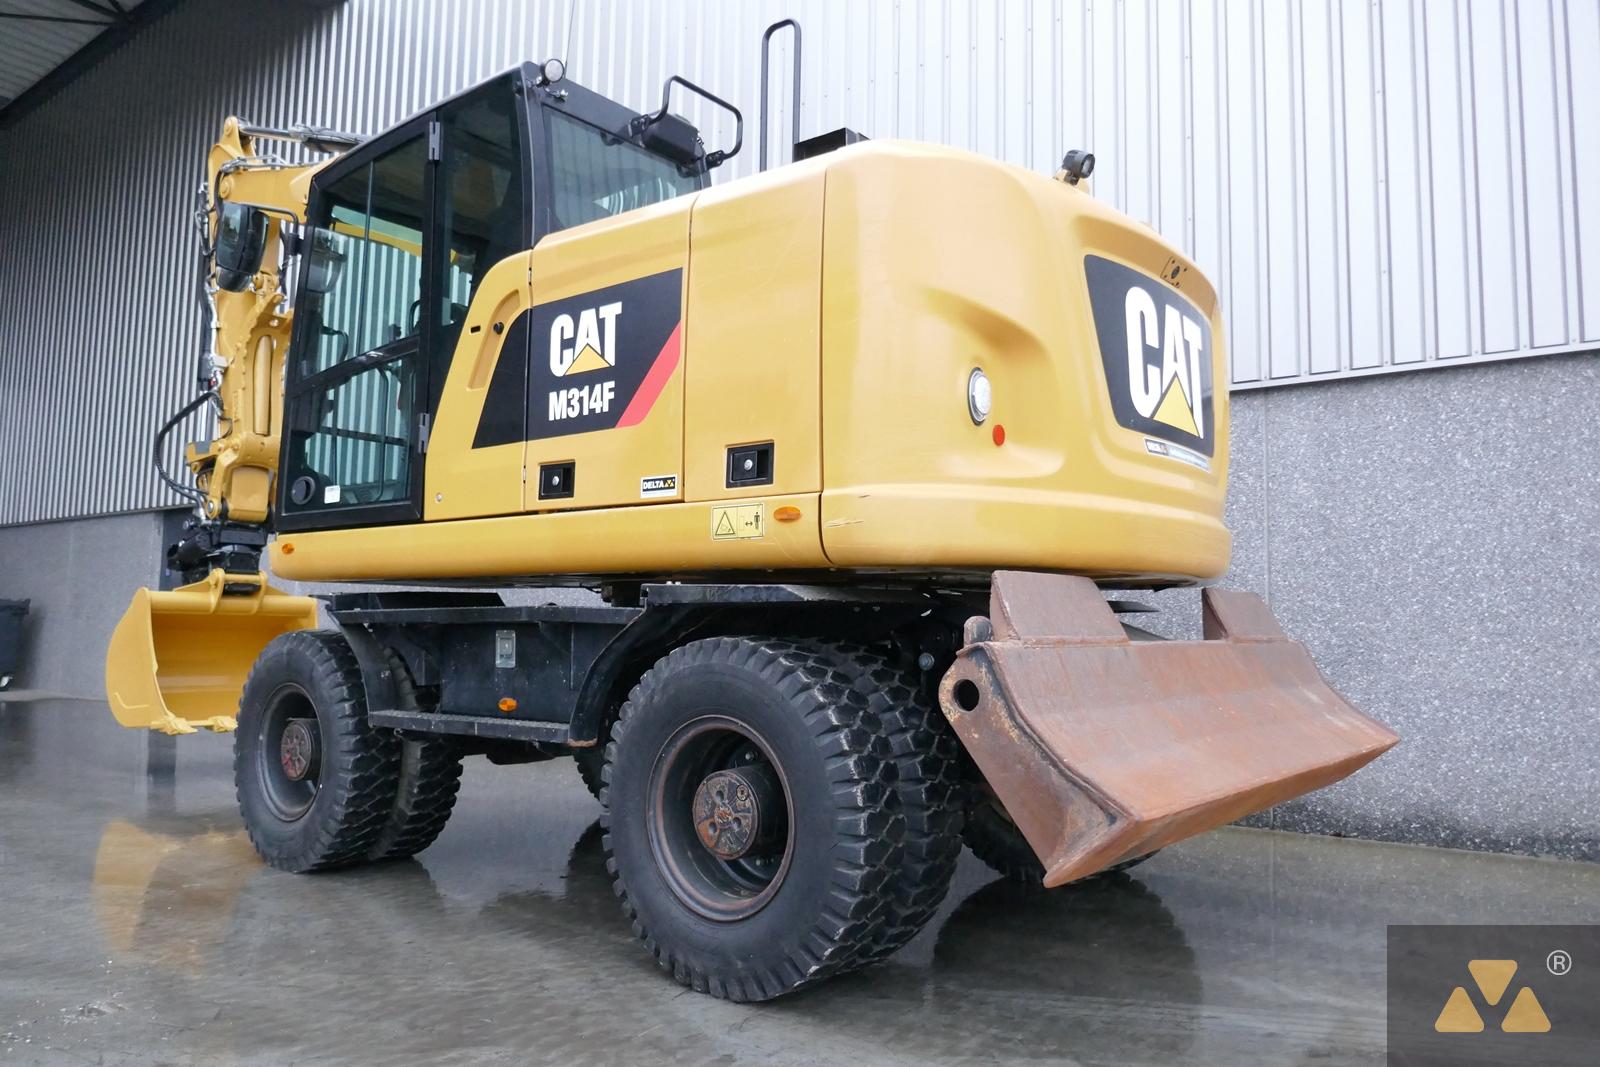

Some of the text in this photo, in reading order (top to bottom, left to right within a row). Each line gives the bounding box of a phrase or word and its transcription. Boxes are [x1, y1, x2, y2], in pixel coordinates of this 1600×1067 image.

[549, 301, 623, 377] CAT
[1125, 286, 1204, 439] CAT
[548, 380, 615, 421] M314F
[643, 480, 665, 490] DELTA
